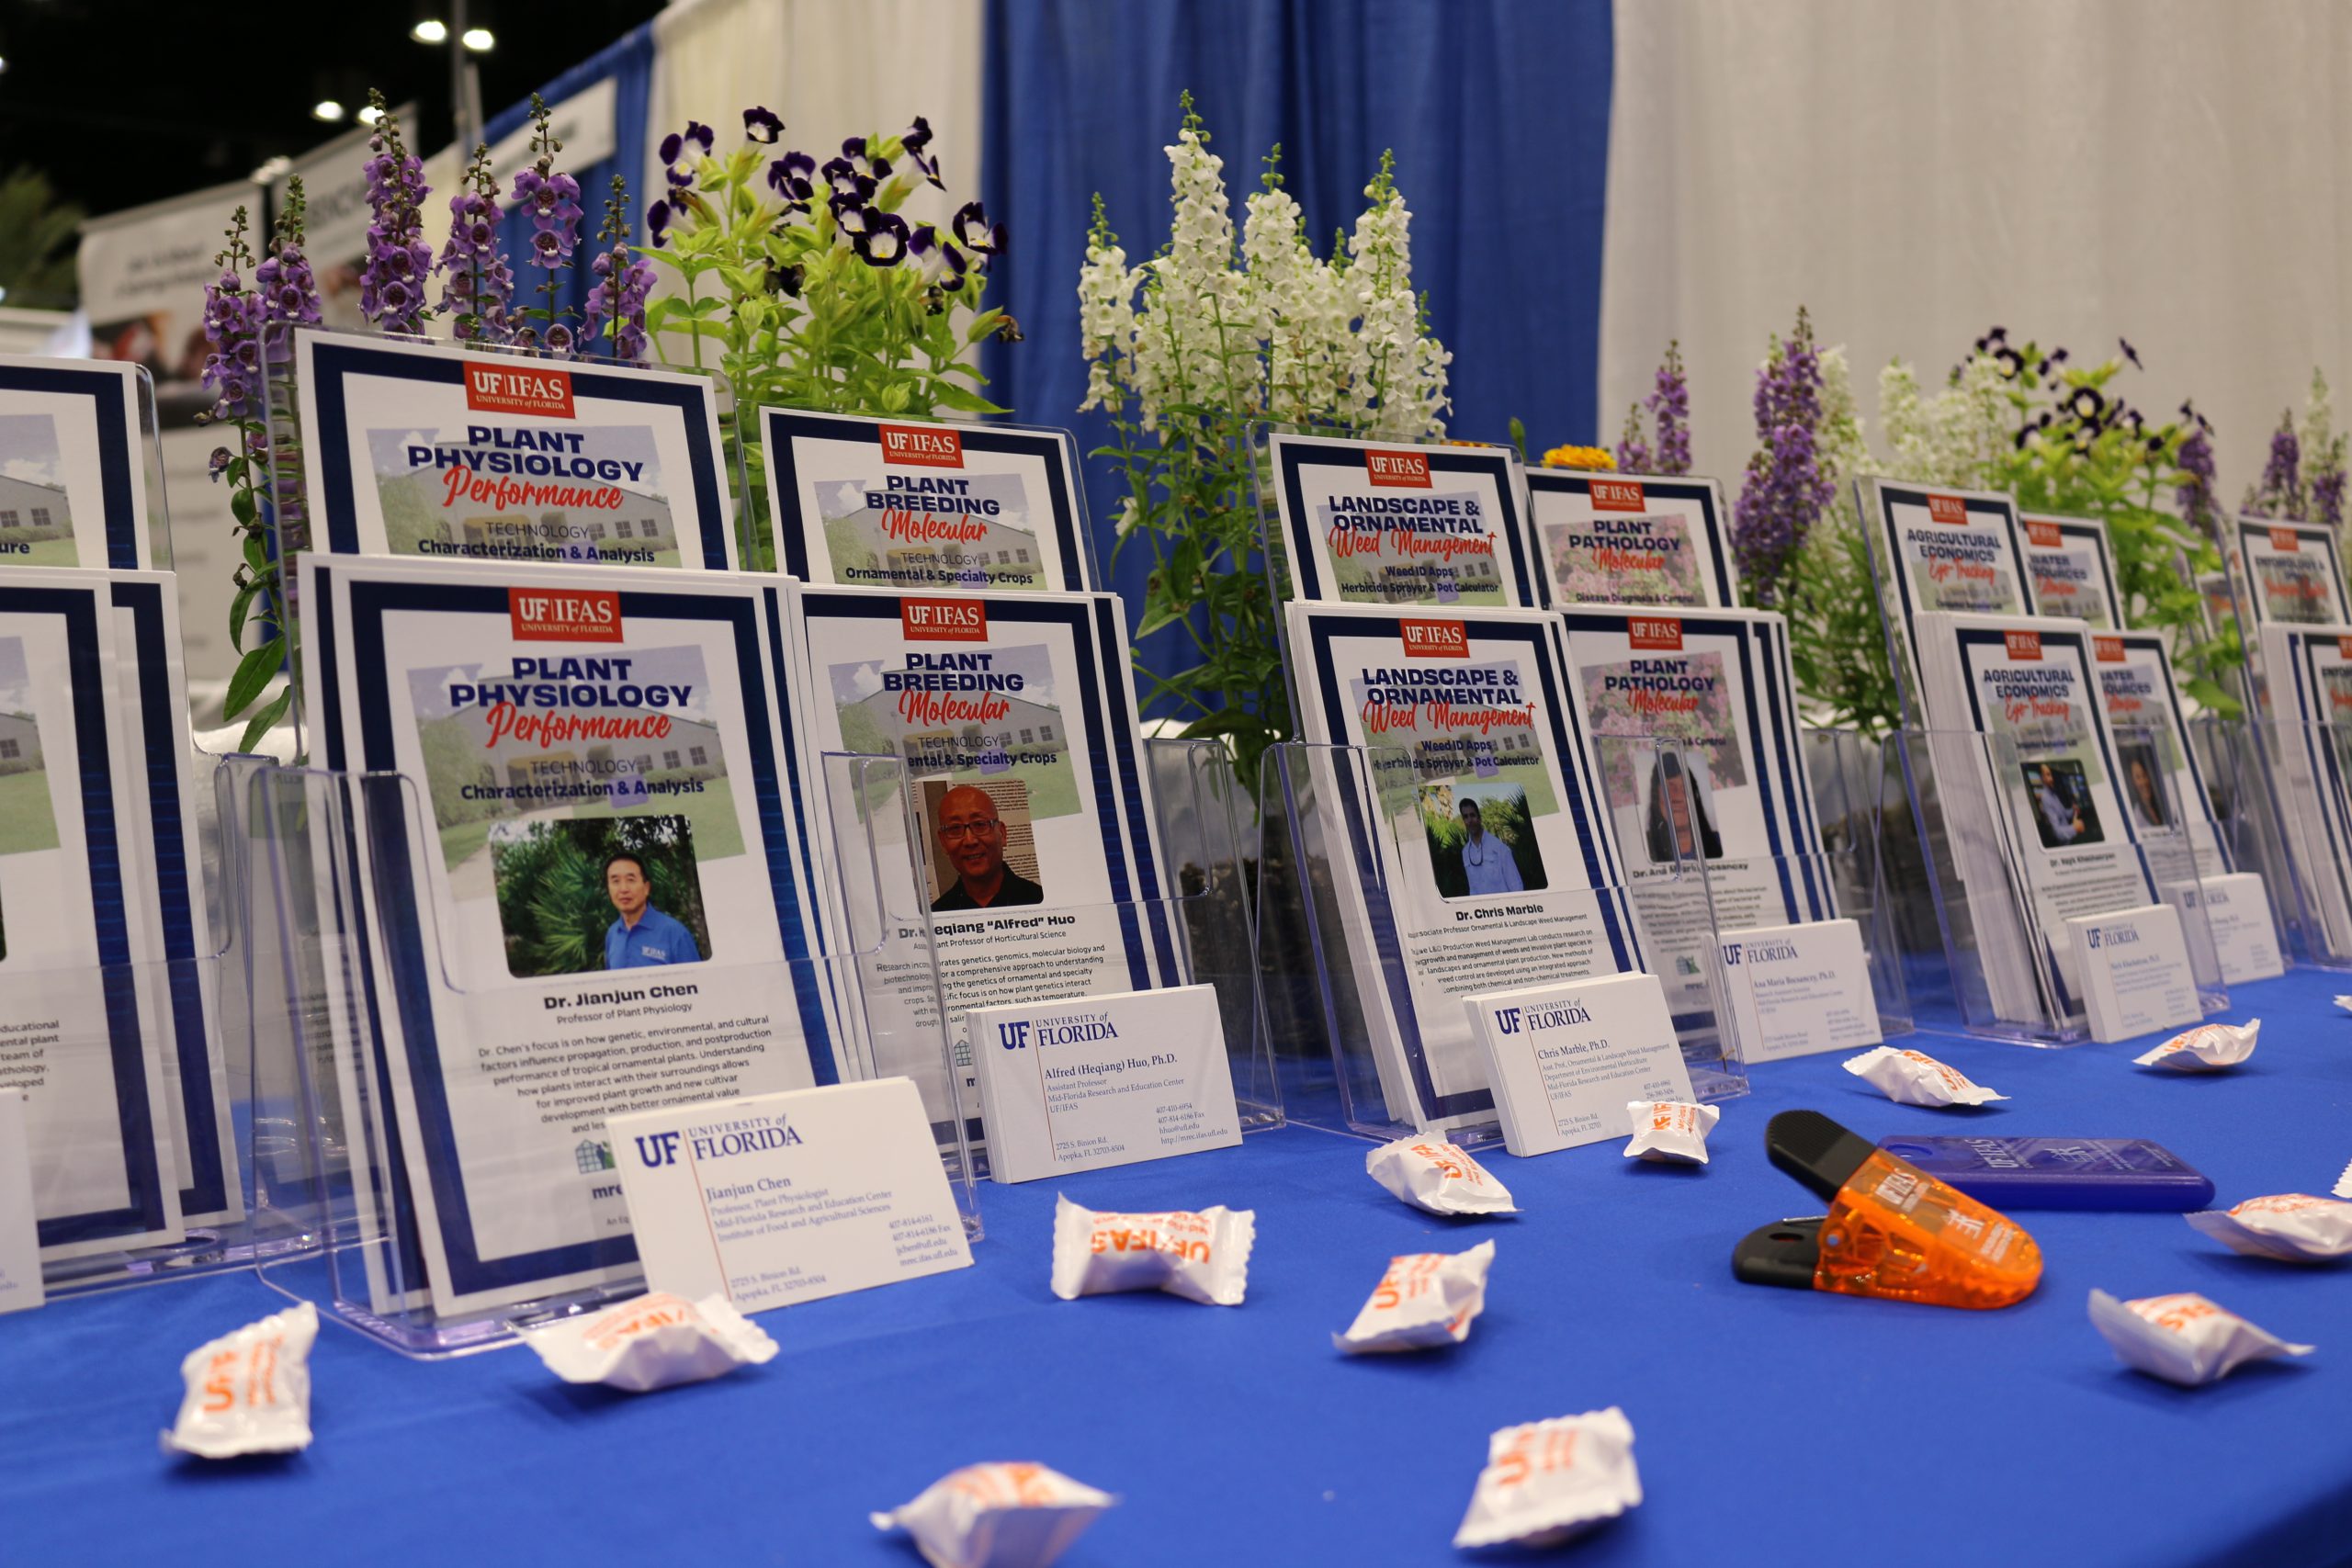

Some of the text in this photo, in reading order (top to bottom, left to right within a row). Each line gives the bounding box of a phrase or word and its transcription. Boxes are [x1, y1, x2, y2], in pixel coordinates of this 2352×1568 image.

[476, 395, 566, 410] UNIVERSITY of FLORIDA
[468, 425, 584, 454] PLANT
[408, 446, 643, 482] PHYSIOLOGY
[443, 464, 624, 511] Performance
[886, 475, 969, 495] PLANT
[866, 492, 1000, 515] BREEDING
[1329, 495, 1463, 515] LANDSCAPE
[485, 522, 589, 539] TECHNOLOGY
[882, 508, 987, 545] Molecular
[1333, 514, 1483, 534] ORNAMENTAL
[1593, 520, 1652, 535] PLANT
[1329, 526, 1497, 562] Weed Management
[1569, 535, 1680, 551] PATHOLOGY
[1907, 529, 2001, 549] AGRICULTURAL
[418, 539, 655, 564] Characterization & Analysis
[900, 552, 977, 565] TECHNOLOGY
[1592, 544, 1665, 573] Molecular
[1919, 545, 1996, 562] ECONOMICS
[846, 567, 1033, 585] Ornamental & Specialty Crops
[1428, 567, 1454, 579] Apps
[1341, 582, 1499, 594] Herbicide Sprayer & Pot Calculator
[521, 624, 571, 633] UNIVERSITY
[580, 625, 614, 634] FLORIDA
[512, 658, 632, 681] PLANT
[906, 653, 992, 671] PLANT
[1631, 660, 1688, 674] PLANT
[883, 673, 1024, 692] BREEDING
[1362, 668, 1519, 685] LANDSCAPE &
[1605, 676, 1715, 691] PATHOLOGY
[1984, 669, 2075, 682] AGRICULTURAL
[450, 684, 692, 708] PHYSIOLOGY
[1367, 689, 1521, 705] ORNAMENTAL
[1628, 687, 1699, 714] Molecular
[1996, 685, 2070, 698] ECONOMICS
[898, 690, 1010, 727] Molecular
[1362, 700, 1536, 735] Weed Management
[485, 701, 672, 749] Performance
[918, 736, 999, 748] TECHNOLOGY
[1466, 740, 1492, 752] Apps
[530, 759, 637, 775] TECHNOLOGY
[945, 752, 1057, 767] & Specialty Crops
[1426, 756, 1539, 771] Sprayer Pot Calculator
[461, 777, 705, 801] Characterization & Analysis
[1048, 915, 1075, 925] Huo
[1456, 904, 1544, 921] Dr. Chris Marble
[950, 937, 984, 947] Professor
[995, 932, 1039, 942] Horticultural
[1040, 930, 1066, 938] Science
[2104, 929, 2139, 947] FLORIDA
[1722, 944, 1742, 965] UF
[1747, 946, 1798, 963] FLORIDA
[544, 983, 699, 1010] Dr. Jianjun Chen
[960, 991, 979, 999] focus
[999, 986, 1014, 994] how
[1016, 985, 1033, 994] plant
[1034, 982, 1063, 992] genetics
[1065, 979, 1091, 988] interact
[556, 1002, 693, 1025] Professor of Plant Physiology
[1524, 998, 1581, 1014] UNIVERSITY of
[1036, 1011, 1108, 1028] UNIVERSITY of
[1495, 1008, 1520, 1035] UF
[1527, 1007, 1592, 1031] FLORIDA
[999, 1021, 1030, 1050] UF
[1037, 1022, 1118, 1046] FLORIDA
[1537, 1039, 1610, 1060] Chris Marble, Ph.D.
[1045, 1053, 1177, 1079] Alfred (Heqiang) Huo, Ph.D.
[1047, 1078, 1107, 1092] Assistant Professor
[1048, 1078, 1184, 1103] Mid-Florida Research and Education Center
[689, 1113, 787, 1138] UNIVERSITY of
[635, 1131, 680, 1168] UF
[693, 1126, 803, 1160] FLORIDA
[705, 1175, 791, 1203] Jianjun Chen
